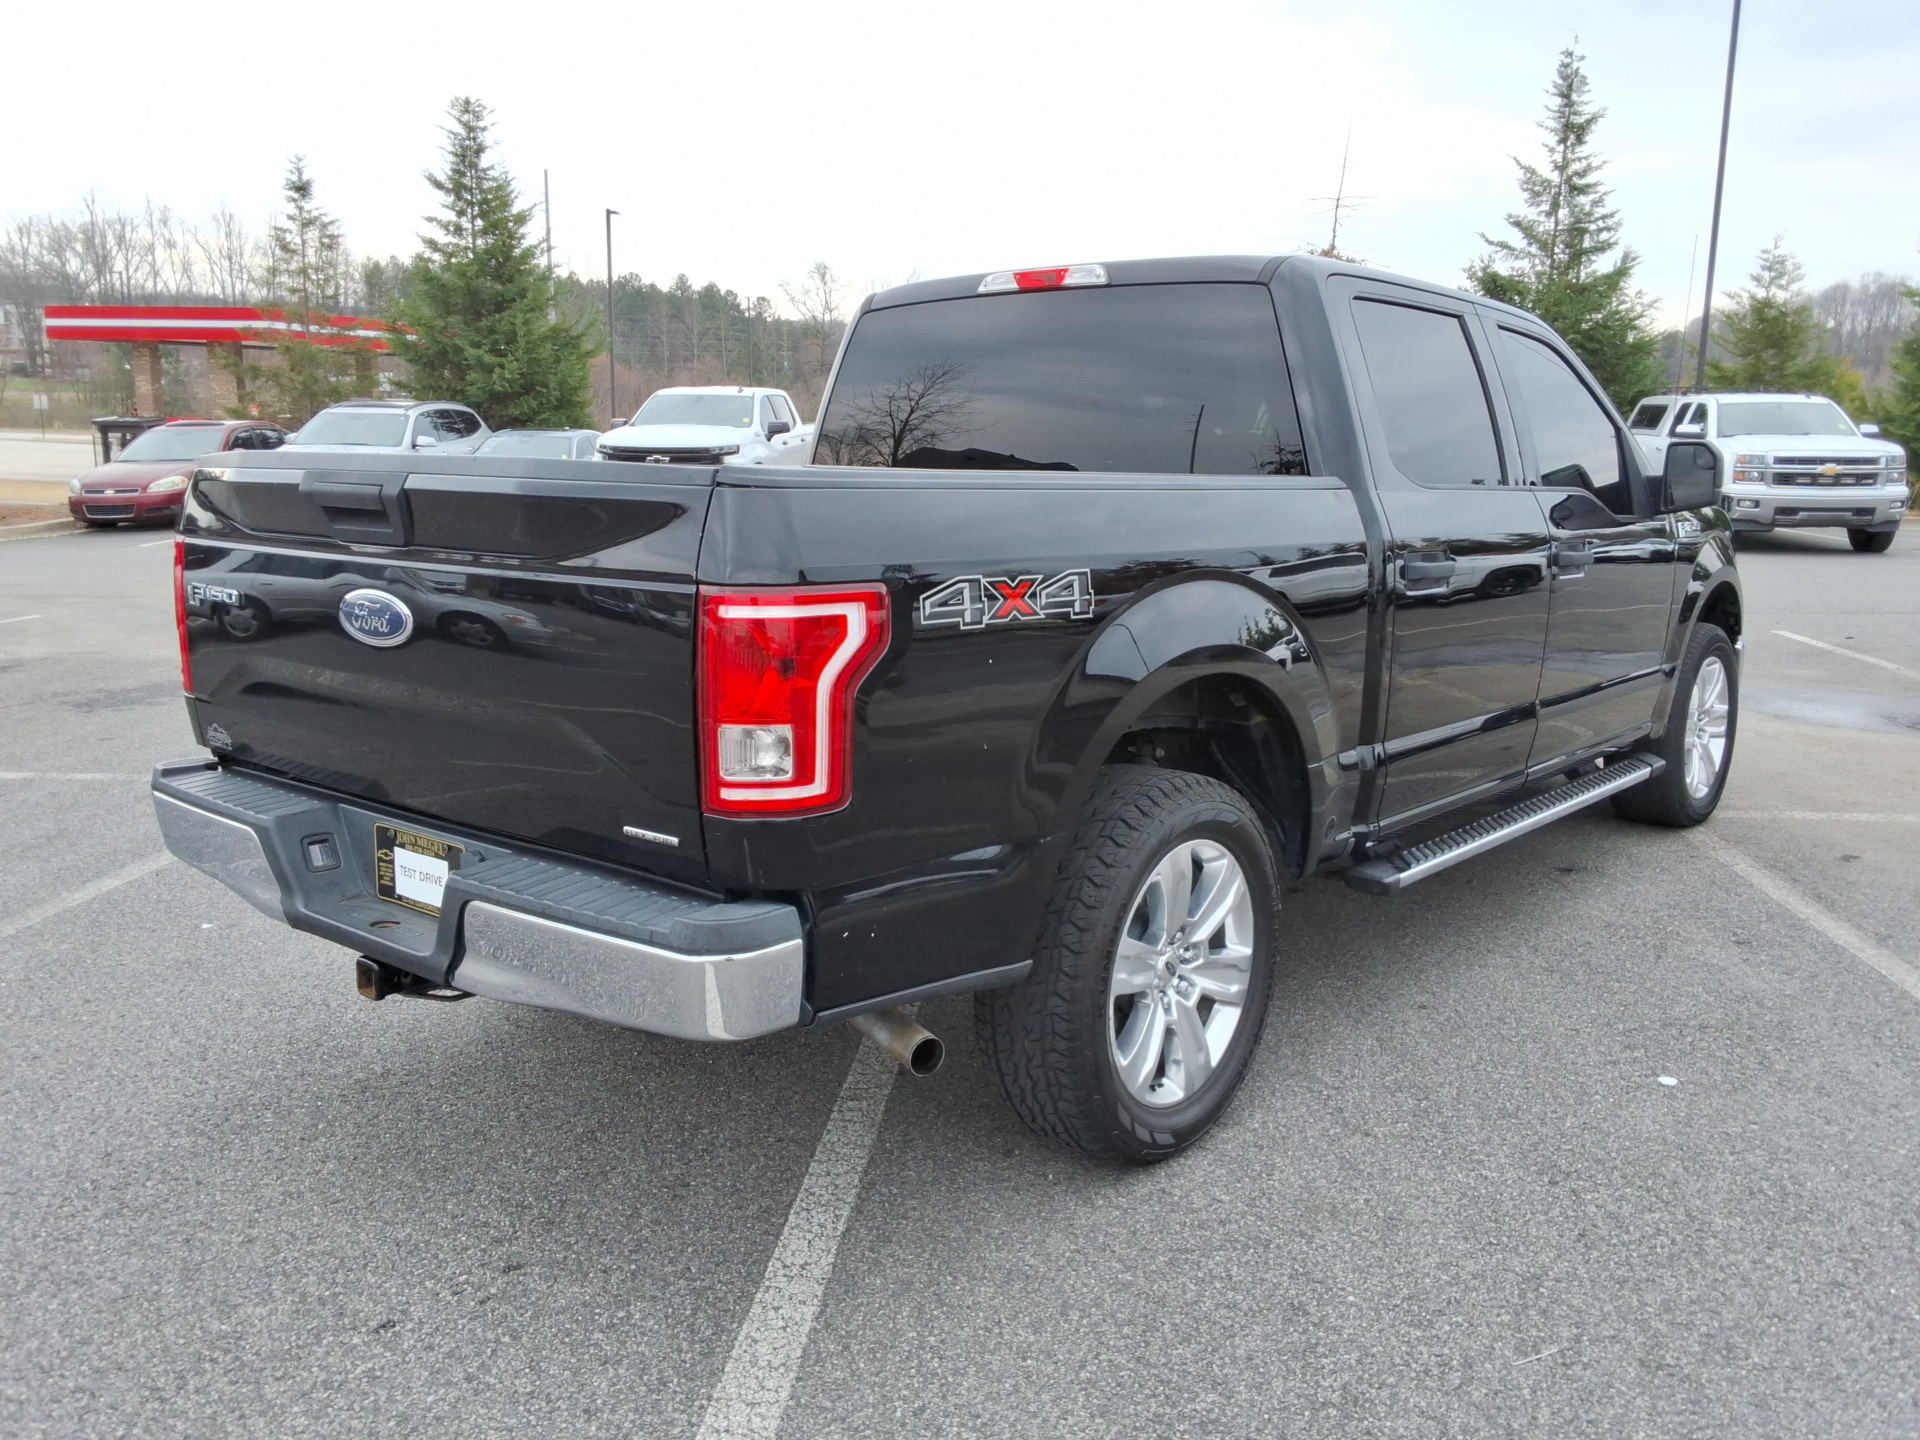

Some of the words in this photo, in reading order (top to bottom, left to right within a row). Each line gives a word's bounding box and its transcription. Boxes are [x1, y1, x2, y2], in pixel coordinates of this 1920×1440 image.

[352, 600, 391, 633] Ford
[395, 830, 415, 845] JOHN
[416, 836, 446, 858] MEGEL
[624, 828, 647, 839] FLEX
[653, 835, 677, 846] FUEL
[399, 864, 417, 879] TEST
[419, 871, 444, 888] DRIVE
